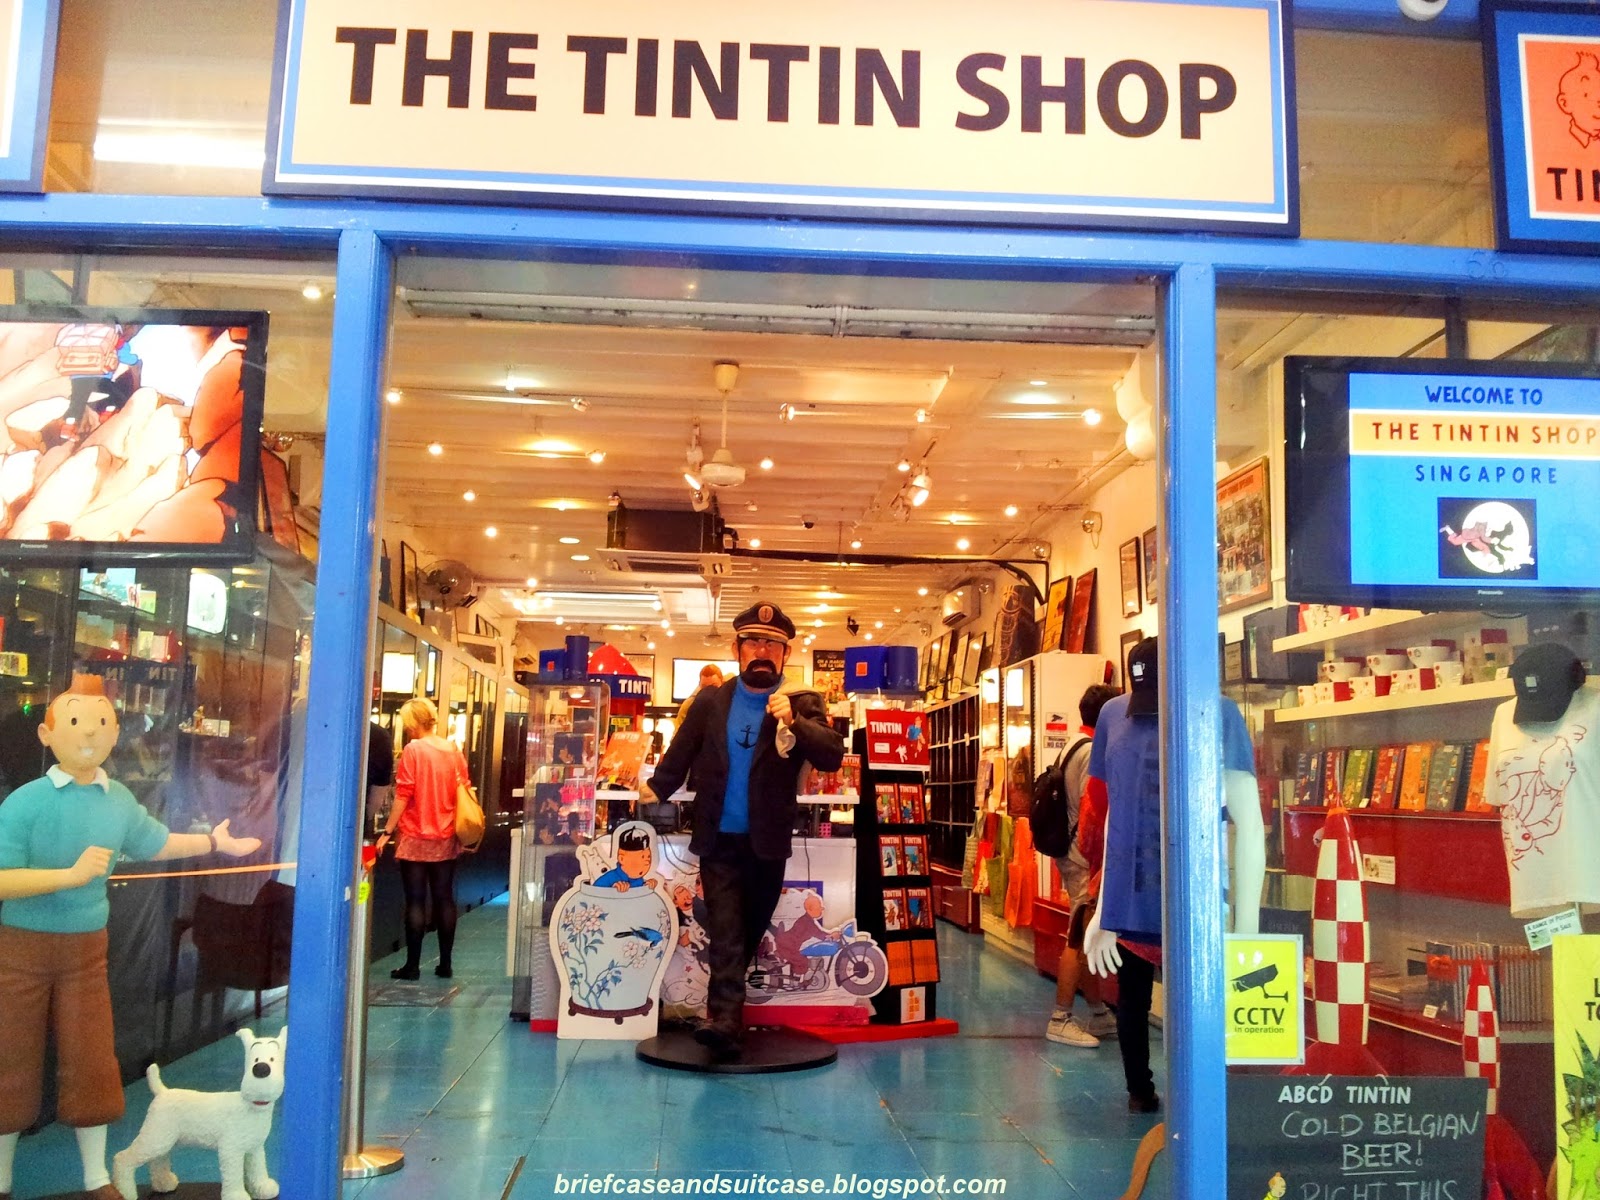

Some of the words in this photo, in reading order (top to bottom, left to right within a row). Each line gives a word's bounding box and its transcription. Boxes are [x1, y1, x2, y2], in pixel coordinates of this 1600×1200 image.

[336, 26, 538, 112] THE
[567, 35, 921, 128] TINTIN
[954, 52, 1237, 140] SHOP
[1425, 385, 1514, 405] WELCOME
[1520, 388, 1543, 405] TO
[1372, 422, 1419, 440] THE
[1433, 423, 1519, 442] TINTIN
[1532, 425, 1598, 445] SHOP
[1415, 464, 1558, 484] SINGAPORE
[870, 721, 902, 735] TINTIN
[1233, 1007, 1285, 1026] CCTV
[1245, 1026, 1285, 1035] operation
[1278, 1085, 1333, 1104] ABCD
[1346, 1085, 1411, 1104] TINTIN
[1281, 1111, 1363, 1138] COLD
[1373, 1111, 1479, 1139] BELGIAN
[1340, 1139, 1423, 1170] BEER!
